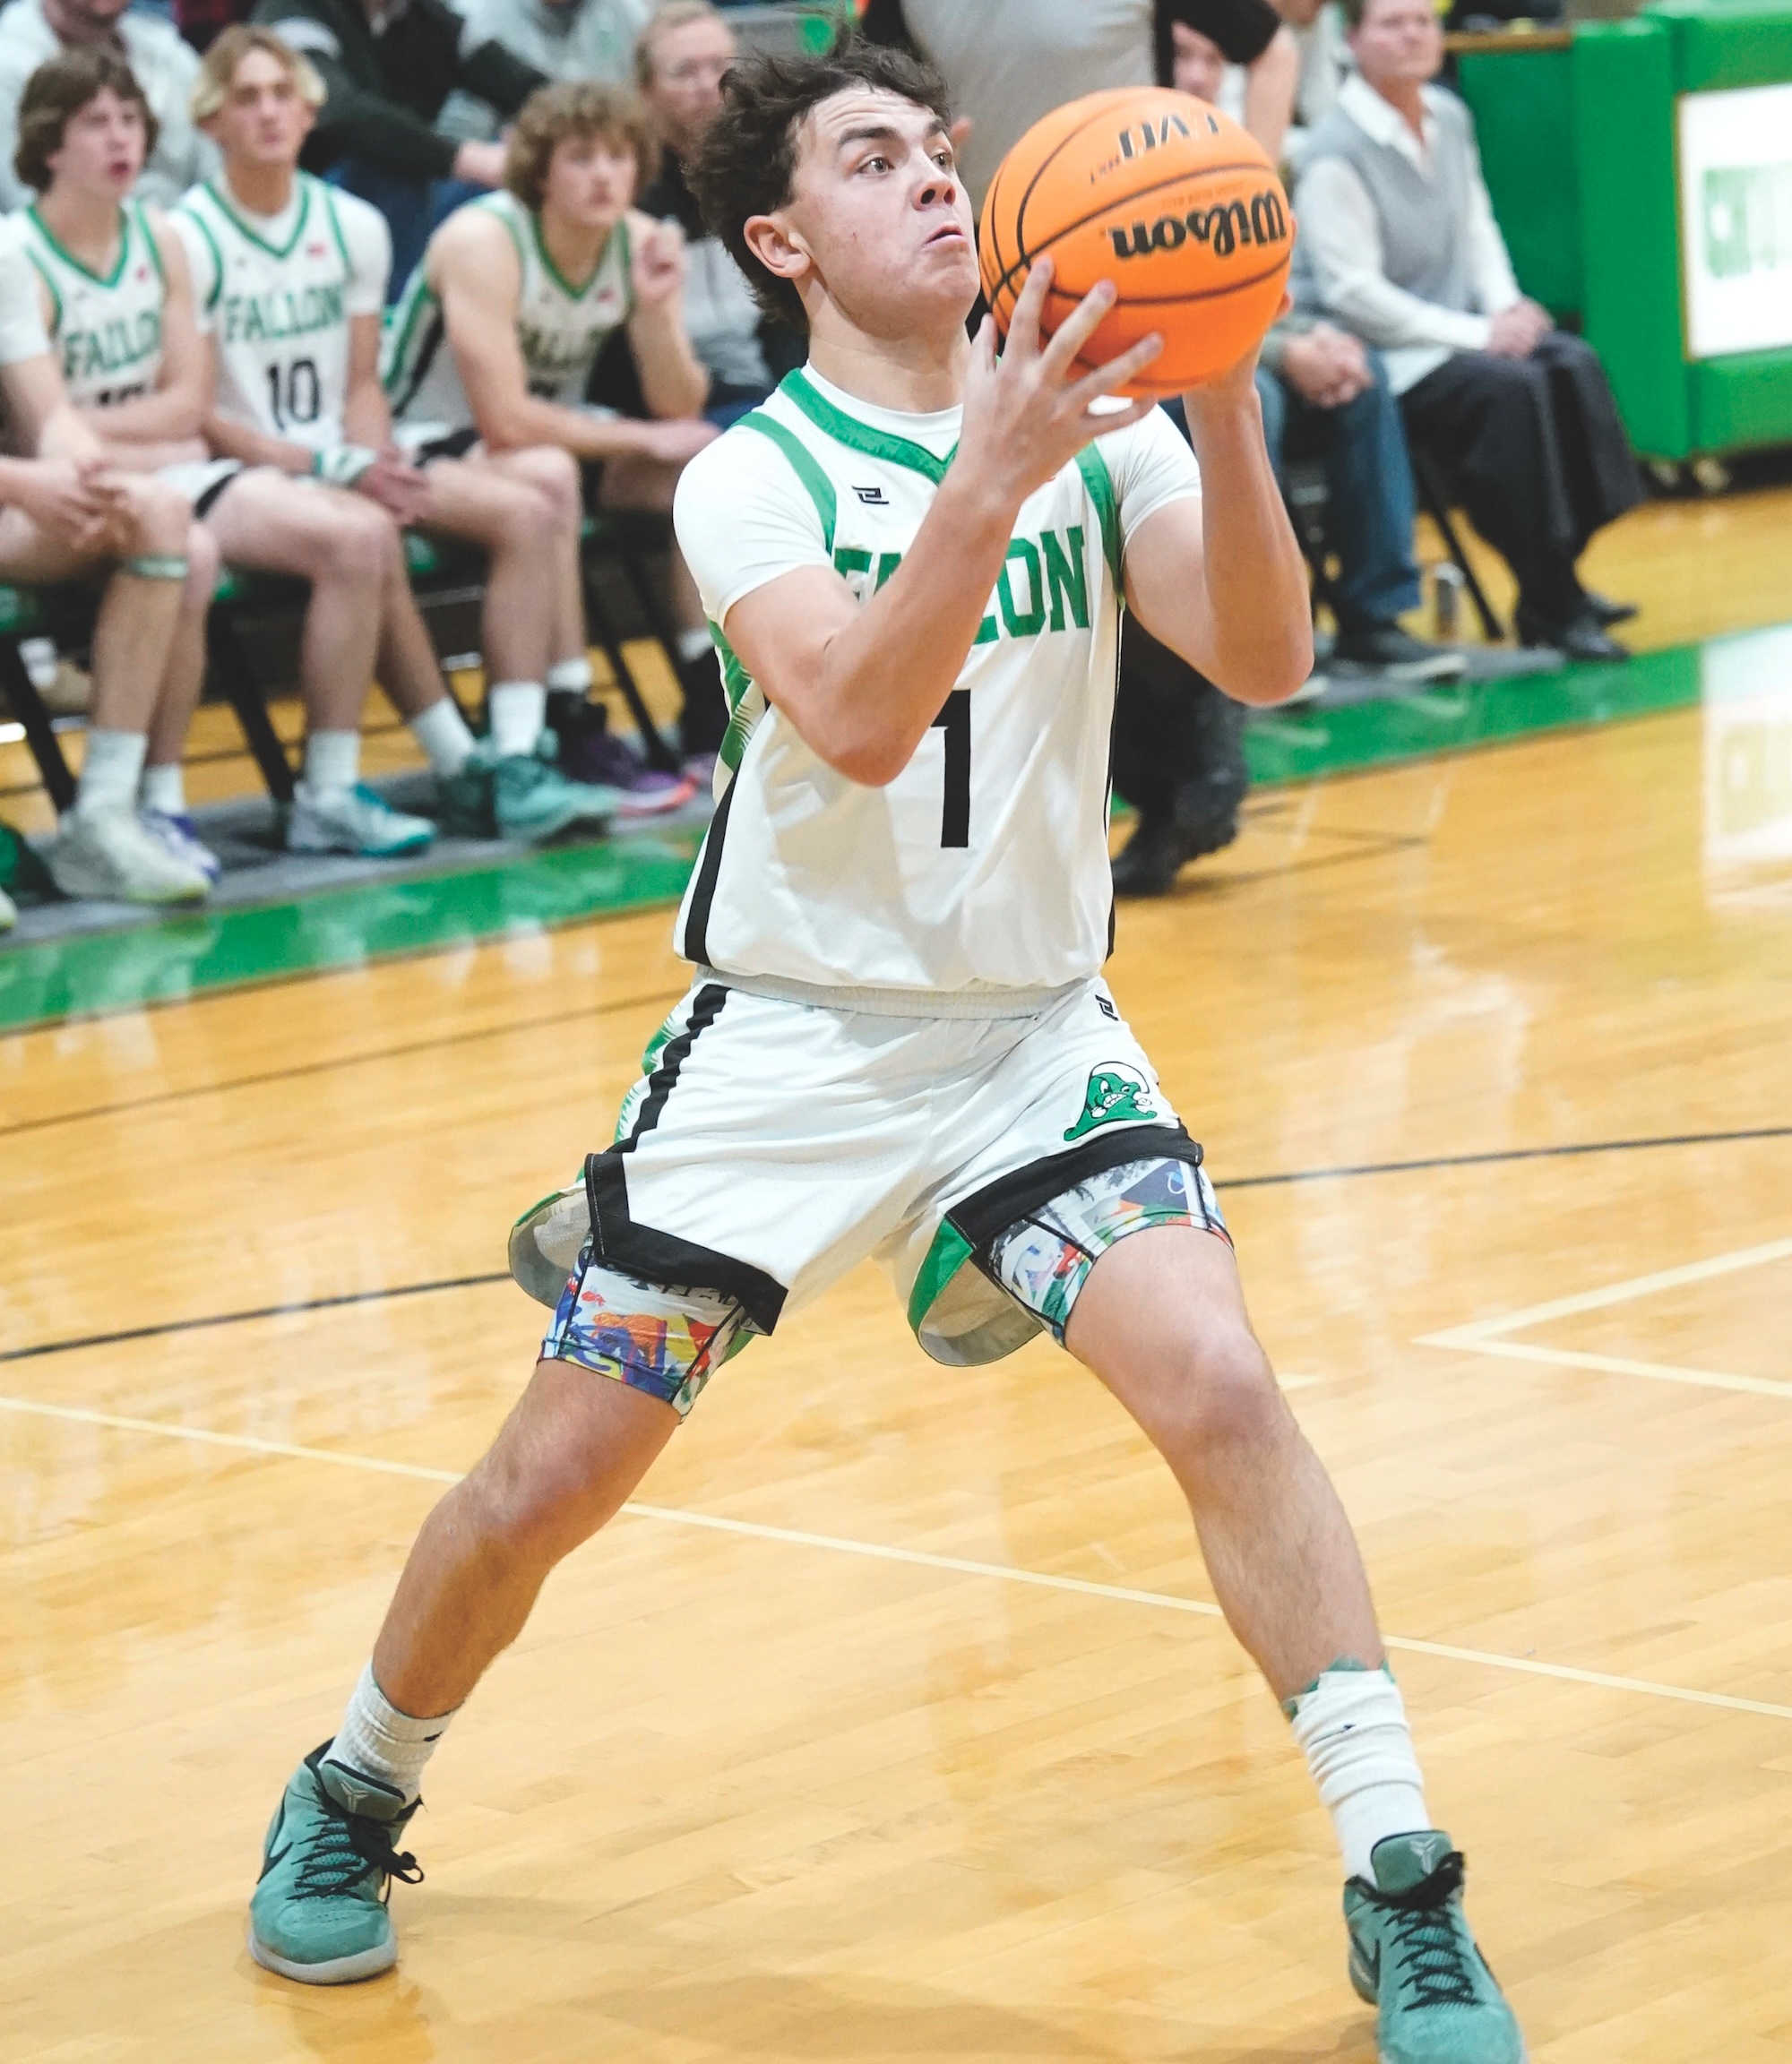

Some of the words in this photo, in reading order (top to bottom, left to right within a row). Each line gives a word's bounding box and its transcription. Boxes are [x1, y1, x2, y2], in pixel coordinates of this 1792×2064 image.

[1111, 188, 1286, 258] Wilson
[226, 285, 342, 343] FALLON
[268, 359, 320, 431] 10
[931, 689, 971, 848] 1
